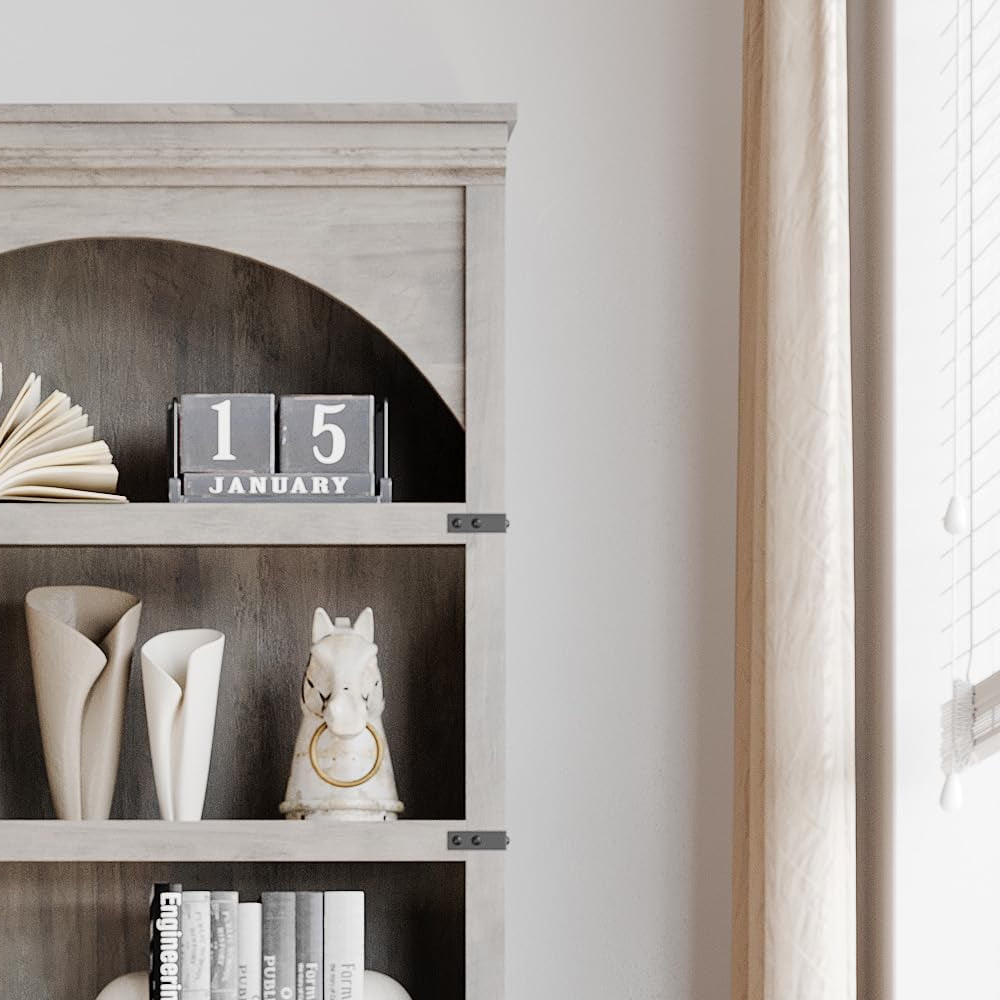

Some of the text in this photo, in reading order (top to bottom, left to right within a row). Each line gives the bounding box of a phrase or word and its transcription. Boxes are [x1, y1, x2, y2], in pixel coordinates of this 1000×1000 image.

[211, 399, 346, 465] 1 5
[208, 476, 349, 495] JANUARY
